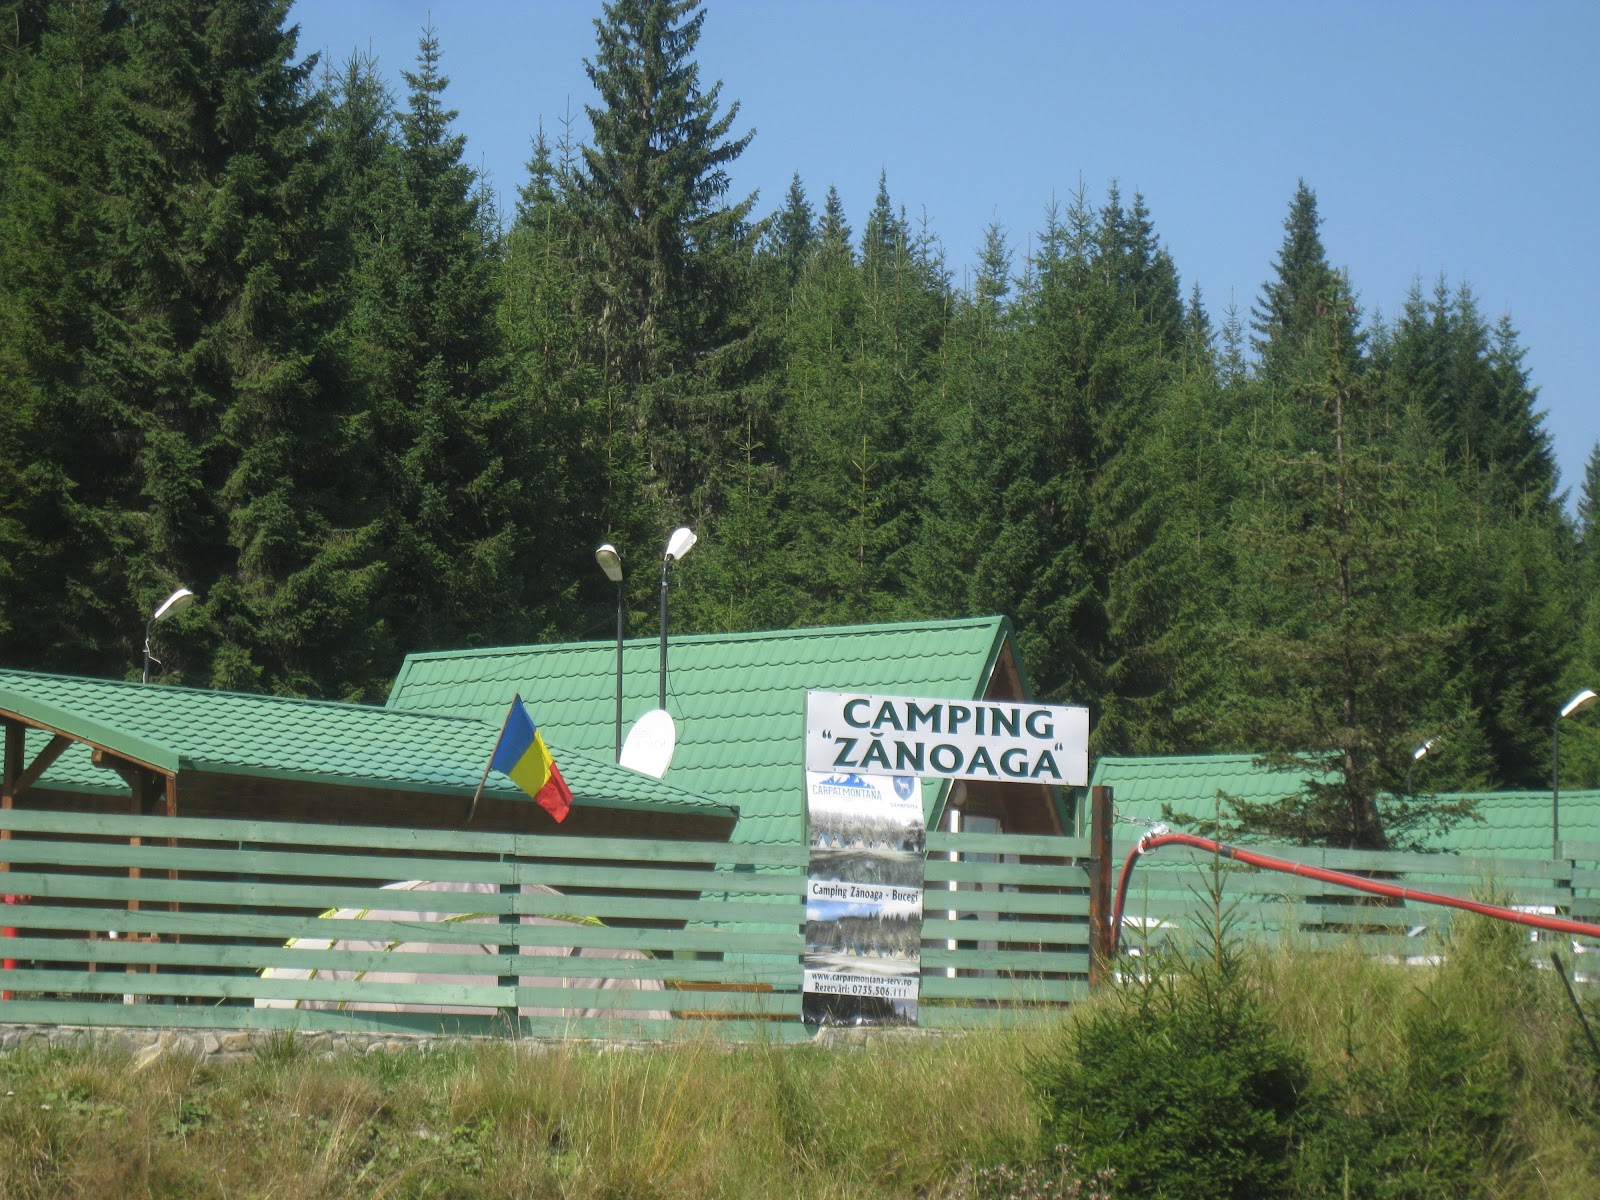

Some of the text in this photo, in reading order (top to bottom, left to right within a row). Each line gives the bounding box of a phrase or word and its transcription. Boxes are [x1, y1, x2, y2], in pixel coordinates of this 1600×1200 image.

[843, 699, 1054, 739] CAMPING
[812, 784, 882, 800] CARPATMONTANA
[812, 883, 847, 899] Camping
[892, 889, 919, 904] Bucegi
[812, 972, 912, 986] www.carpatmontana-serv.ro
[852, 985, 907, 997] 0735.506.111
